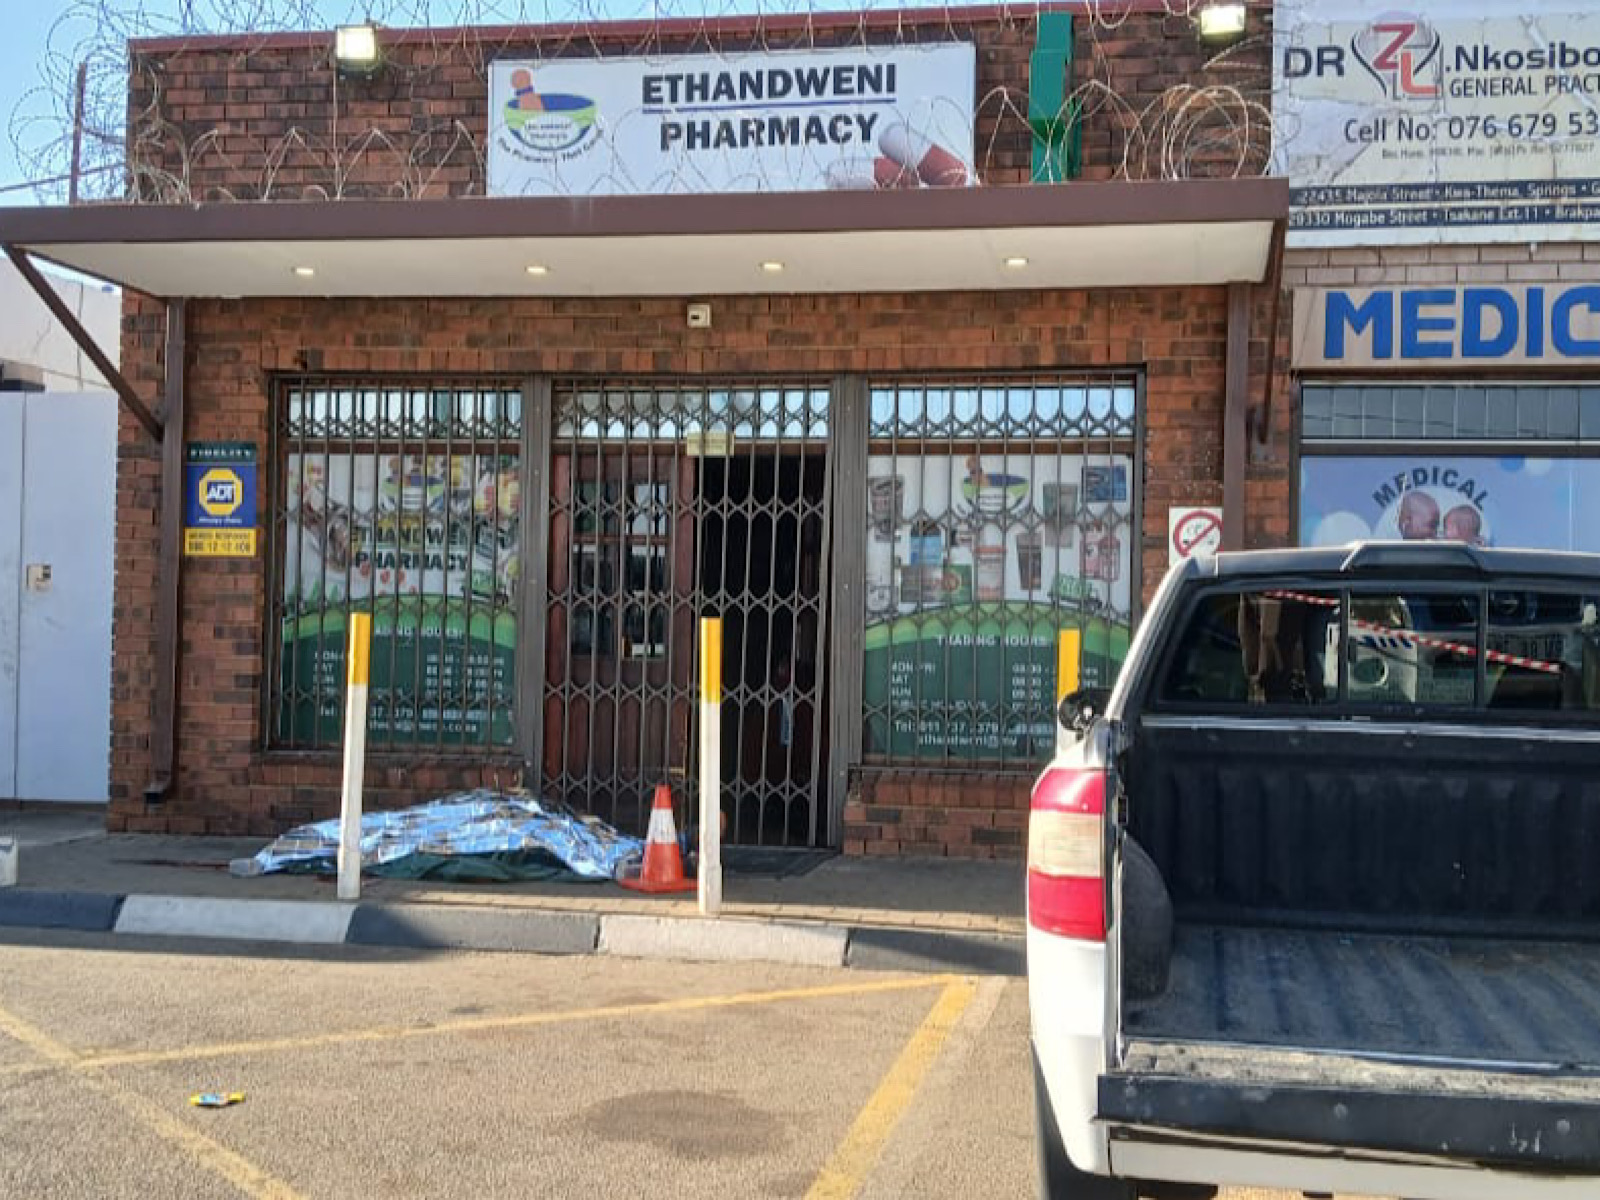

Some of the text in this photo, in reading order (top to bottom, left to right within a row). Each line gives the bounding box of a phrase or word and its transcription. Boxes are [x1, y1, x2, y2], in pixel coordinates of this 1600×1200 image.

[1283, 46, 1345, 78] DR
[642, 62, 897, 105] ETHANDWENI
[1450, 75, 1538, 98] GENERAL
[660, 113, 879, 151] PHARMACY
[1344, 118, 1387, 143] Cell
[1449, 114, 1498, 139] 076
[1507, 112, 1557, 137] 679
[1323, 286, 1600, 359] MEDIC
[207, 484, 234, 500] ADT
[1372, 466, 1489, 513] MEDICAL
[355, 551, 469, 571] PHARMACY
[938, 633, 995, 646] TRADNG
